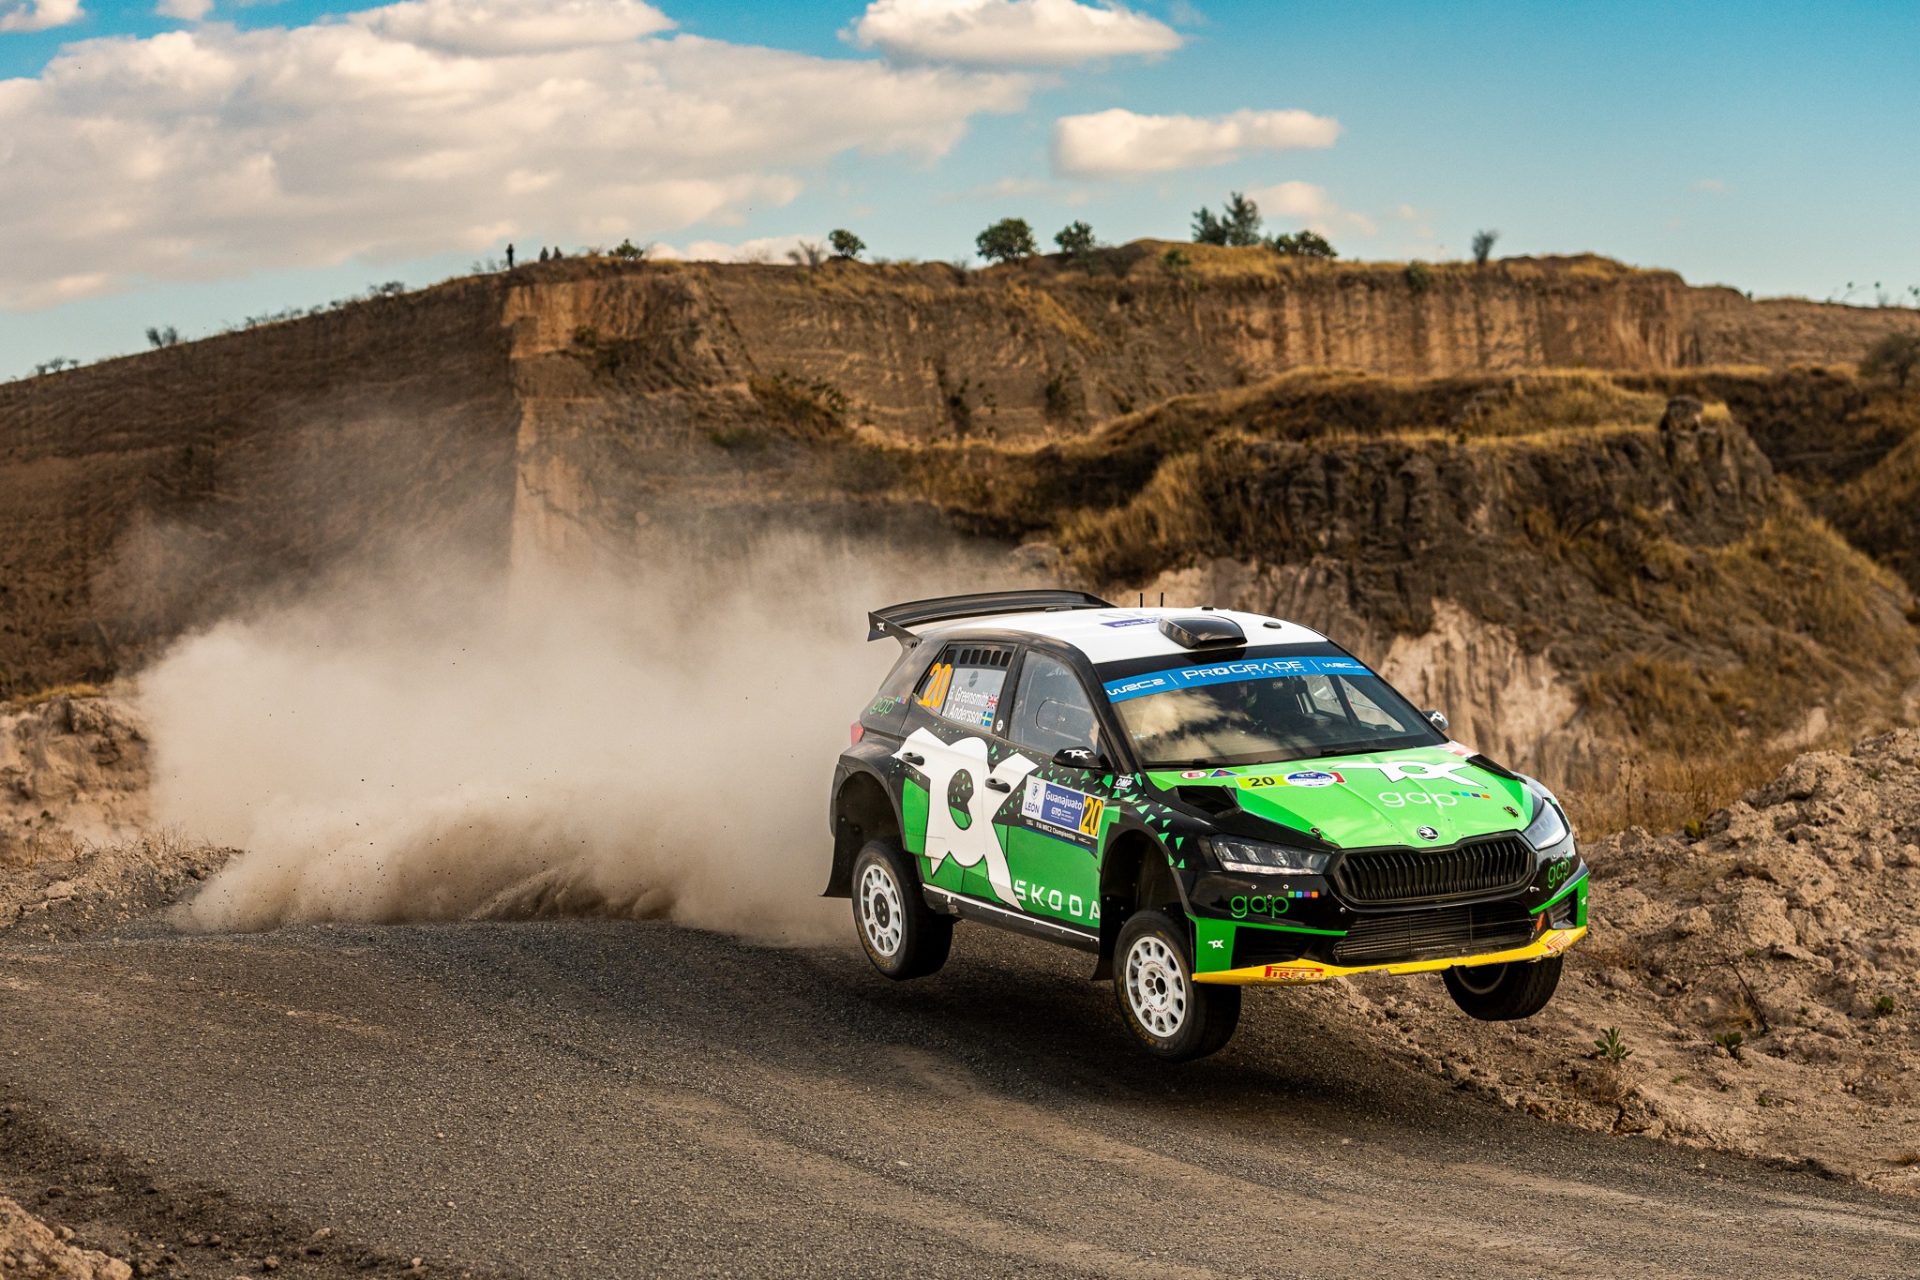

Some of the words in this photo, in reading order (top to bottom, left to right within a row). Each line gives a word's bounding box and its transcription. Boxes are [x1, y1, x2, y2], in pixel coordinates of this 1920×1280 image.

[1182, 661, 1304, 680] PROGRADE
[918, 662, 952, 708] 20
[1248, 777, 1275, 787] 20
[1045, 790, 1083, 810] Guanajuato
[1378, 792, 1457, 809] gap
[1080, 796, 1104, 837] 20
[1230, 895, 1289, 919] gap
